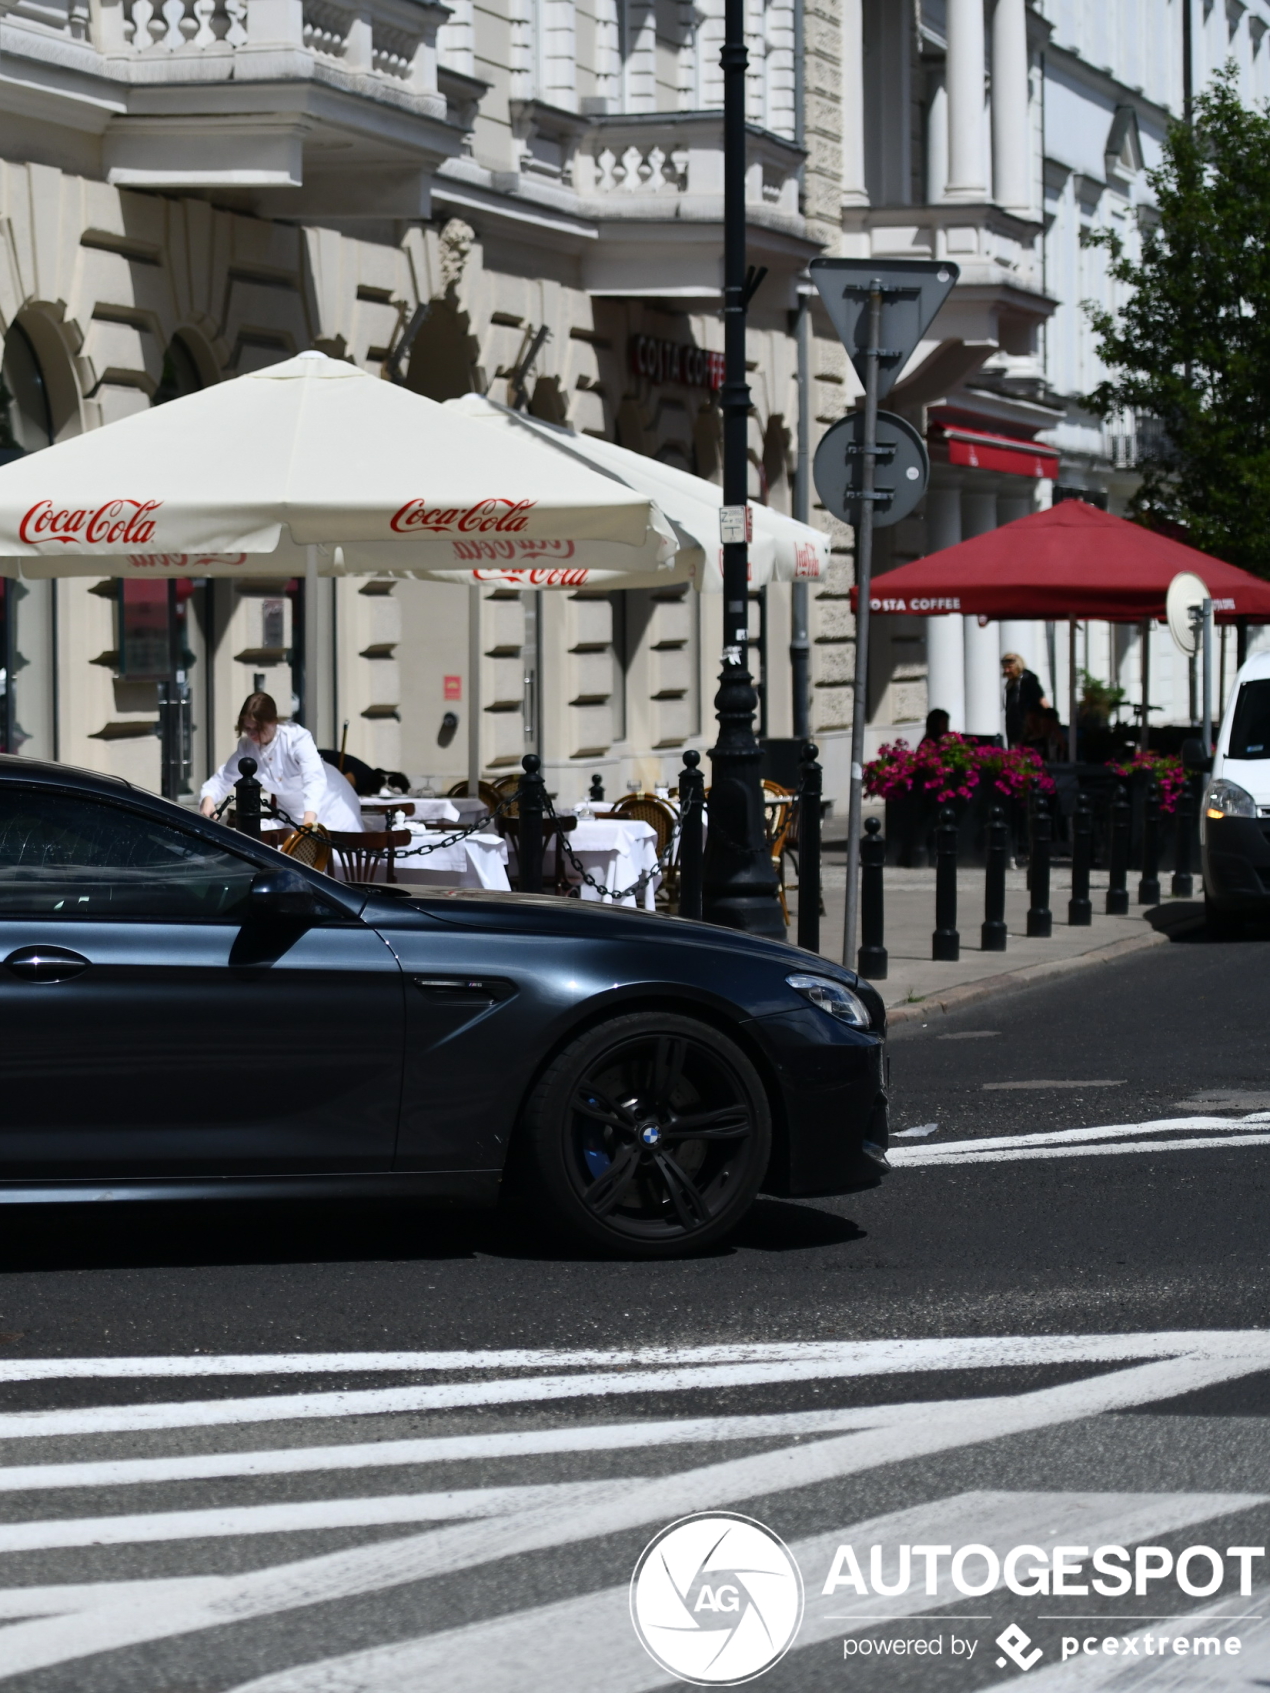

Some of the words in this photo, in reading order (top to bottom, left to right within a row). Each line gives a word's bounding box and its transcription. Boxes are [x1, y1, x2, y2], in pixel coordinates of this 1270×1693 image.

[19, 499, 164, 544] Coca-Cola
[390, 498, 538, 533] Coca-Cola
[870, 598, 907, 612] OSTA
[910, 597, 961, 610] COFFEE
